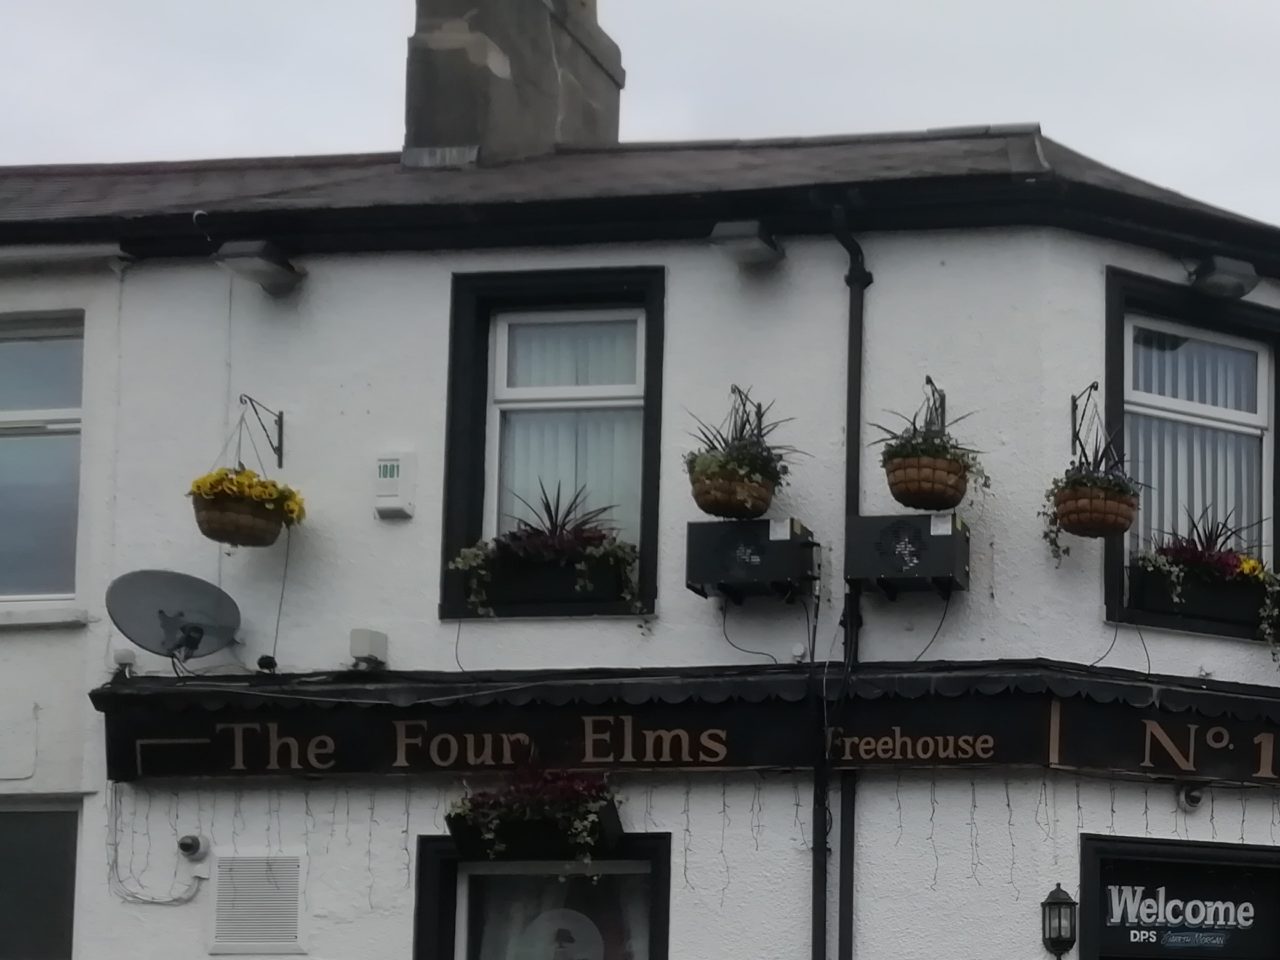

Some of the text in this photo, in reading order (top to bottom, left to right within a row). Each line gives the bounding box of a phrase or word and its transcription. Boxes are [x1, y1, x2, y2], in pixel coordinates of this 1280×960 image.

[216, 715, 728, 769] The Four Elms
[1107, 885, 1255, 930] Welcome
